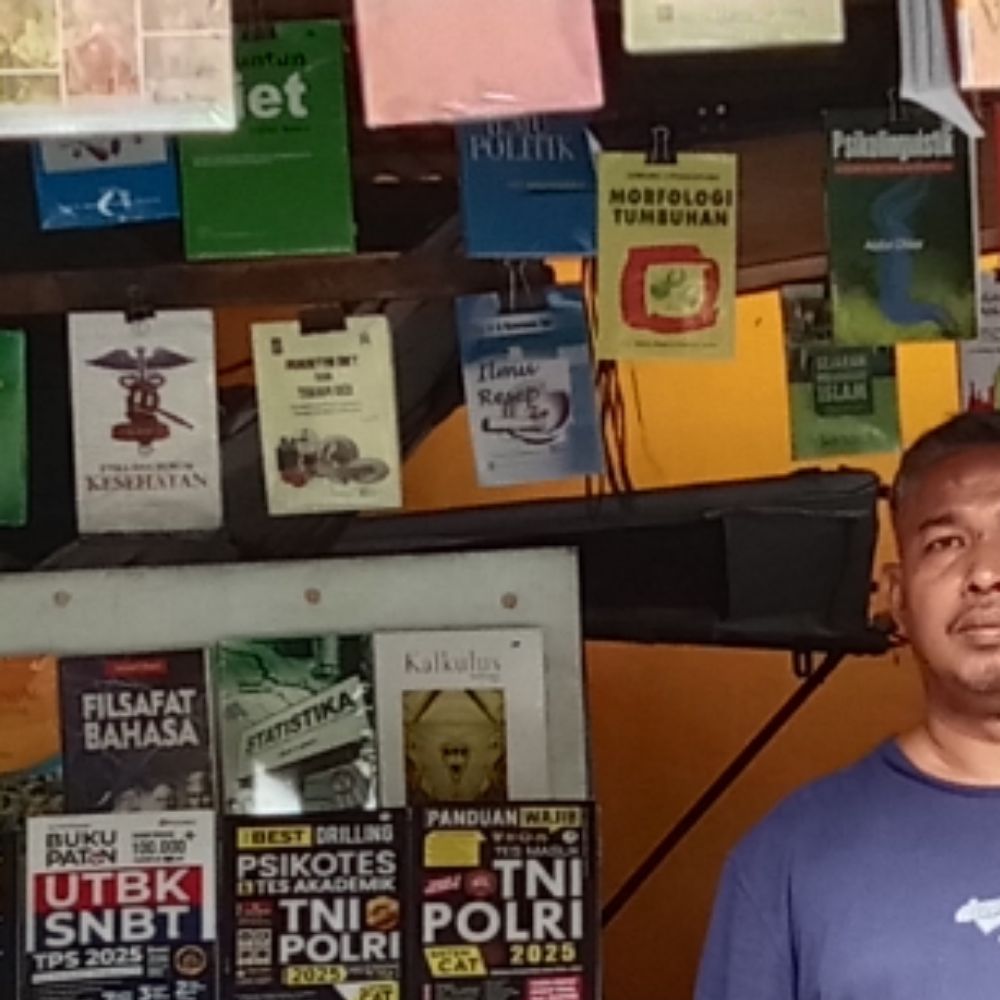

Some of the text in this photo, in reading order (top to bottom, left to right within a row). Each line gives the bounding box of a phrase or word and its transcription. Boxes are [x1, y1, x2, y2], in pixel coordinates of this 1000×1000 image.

[470, 137, 575, 161] POLITIK
[608, 188, 733, 208] MORFOLOGI
[613, 208, 729, 228] TUMBUHAN
[86, 472, 208, 493] KESEHATAN
[404, 650, 502, 676] Kalkulus
[82, 688, 197, 721] FILSAFAT
[84, 717, 200, 751] BAHASA
[244, 690, 357, 754] STATISTIKA
[427, 808, 518, 827] PANDUAN
[45, 829, 118, 849] BUKU
[237, 849, 398, 878] PSIKOTES
[44, 867, 191, 908] UTBK
[492, 858, 584, 900] TNI
[44, 905, 191, 949] SNBT
[278, 897, 362, 934] TNI
[422, 899, 584, 944] POLRI
[33, 944, 143, 971] TPS 2025
[279, 930, 401, 965] POLRI
[508, 943, 577, 966] 2025
[438, 957, 480, 974] CAT
